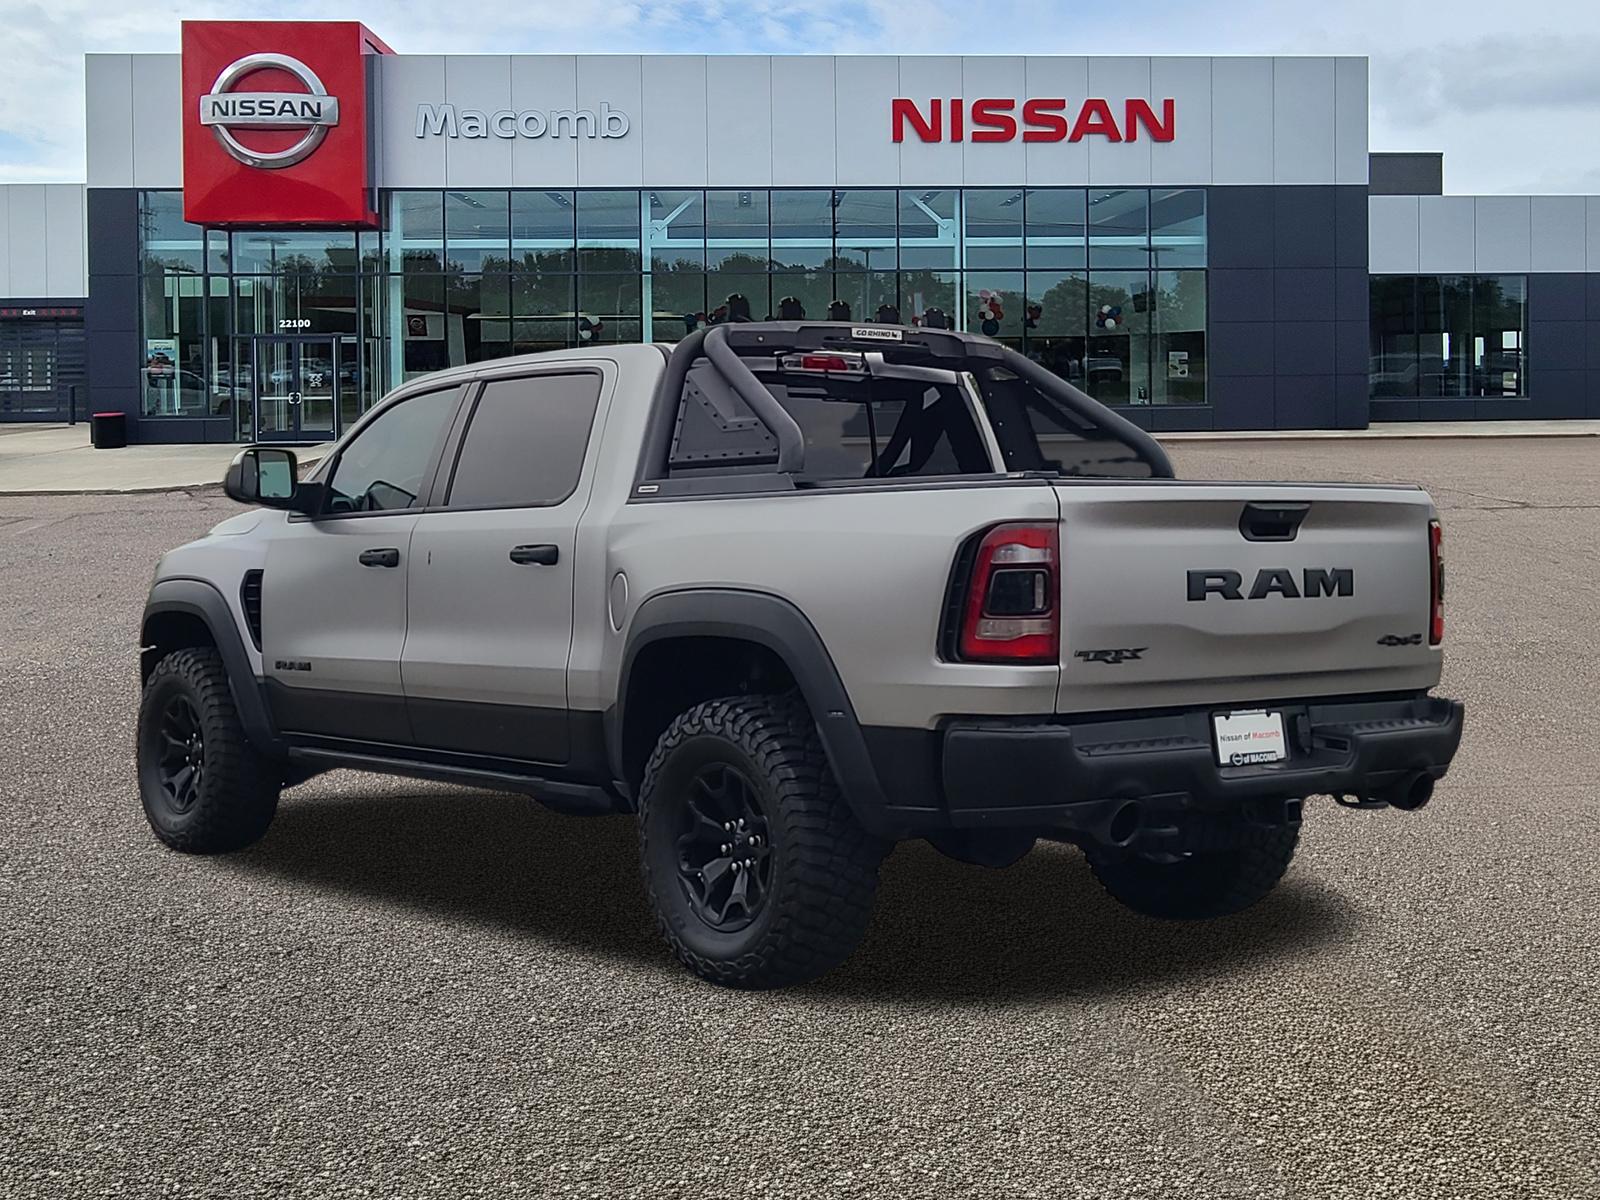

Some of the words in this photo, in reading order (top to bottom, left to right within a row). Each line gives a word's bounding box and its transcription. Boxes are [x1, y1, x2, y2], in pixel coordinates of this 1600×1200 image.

[211, 100, 322, 117] NISSAN
[415, 101, 630, 139] Macomb
[892, 98, 1175, 143] NISSAN
[279, 319, 311, 328] 22100
[1186, 567, 1354, 602] RAM
[1220, 734, 1242, 742] Nissan
[1243, 732, 1251, 740] of
[1252, 730, 1280, 739] Macomb
